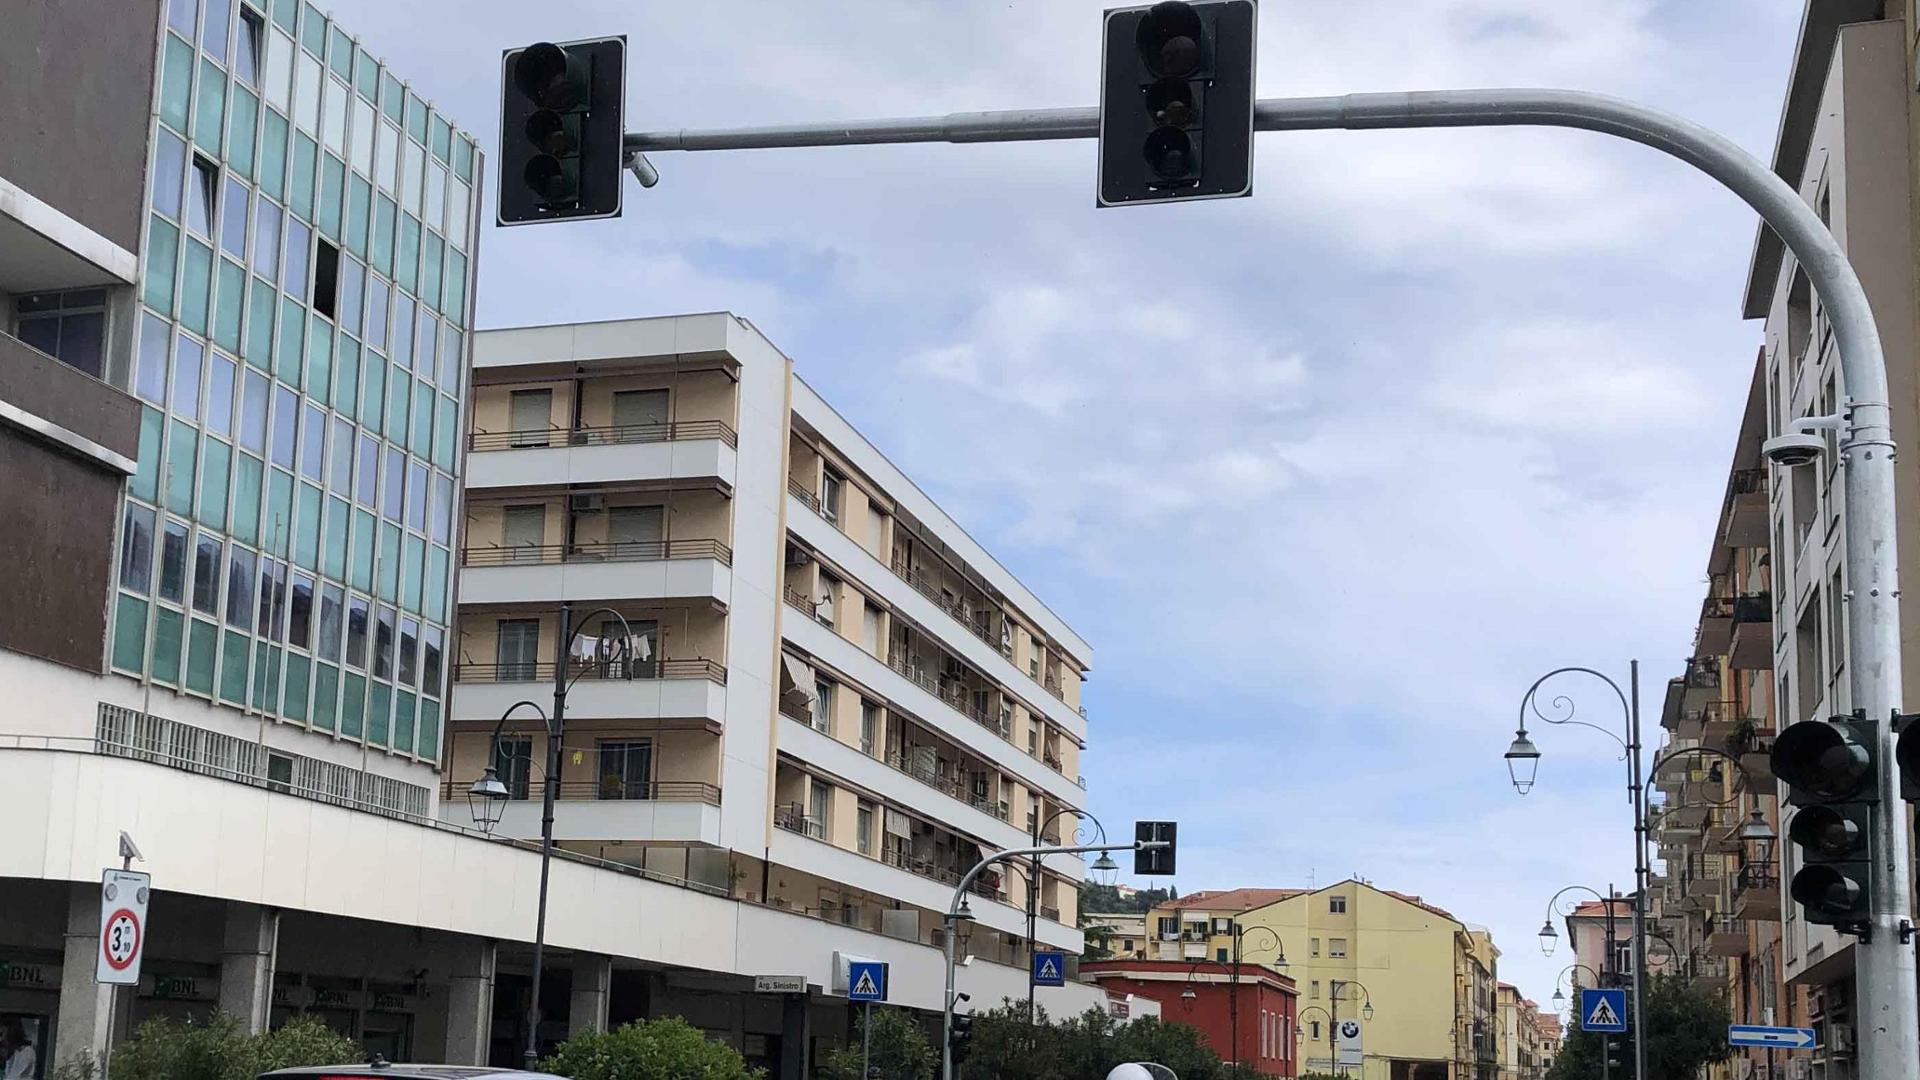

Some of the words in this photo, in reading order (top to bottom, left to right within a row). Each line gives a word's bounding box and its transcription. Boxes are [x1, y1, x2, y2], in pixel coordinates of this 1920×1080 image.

[112, 926, 122, 952] 3
[123, 942, 130, 952] 10
[10, 966, 44, 983] BNL
[171, 979, 200, 993] BNL
[758, 981, 772, 990] Arg.
[273, 988, 288, 1001] NL
[328, 991, 350, 1004] BNL
